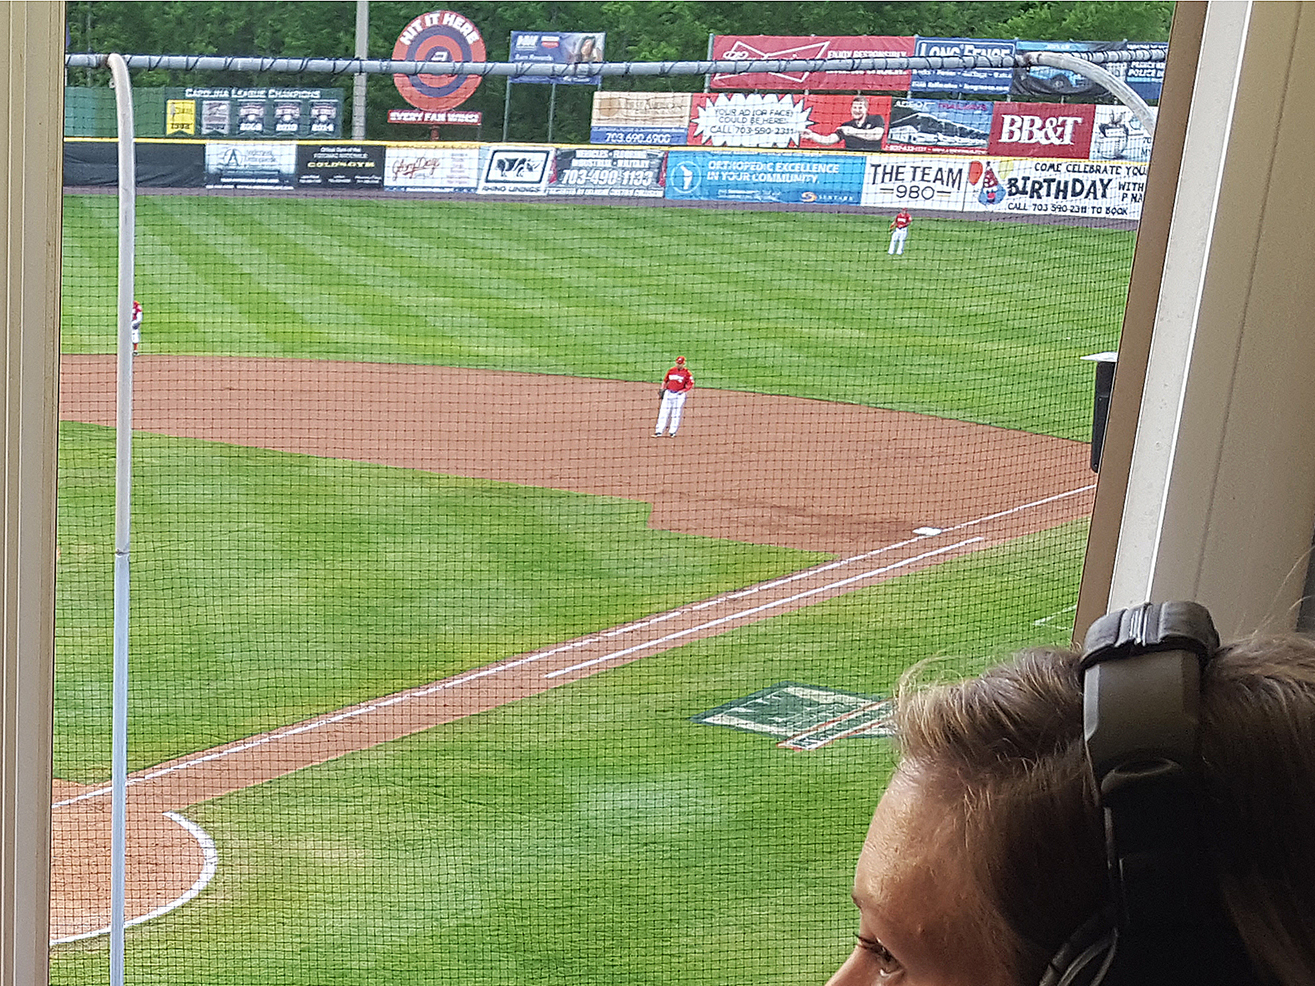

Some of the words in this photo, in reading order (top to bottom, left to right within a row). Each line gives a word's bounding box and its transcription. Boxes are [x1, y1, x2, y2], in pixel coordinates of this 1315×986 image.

[399, 19, 424, 46] HIT
[424, 13, 442, 27] IT
[443, 13, 481, 46] HERE
[185, 88, 229, 98] CAROLINA
[231, 88, 266, 98] LEAGUE
[268, 88, 321, 99] CHAMPIONS
[389, 111, 423, 122] EVERY
[423, 112, 447, 123] FAN
[714, 109, 737, 117] YOUR
[738, 109, 751, 117] AD
[769, 108, 794, 118] FACE)
[719, 116, 747, 125] COULD
[749, 117, 761, 125] BE
[710, 125, 733, 135] CALL
[999, 114, 1082, 146] BB&T
[708, 161, 774, 172] ORTHOPEDIC
[775, 162, 839, 173] EXCELLENCE
[1034, 162, 1062, 172] COME
[1065, 163, 1121, 175] CELEBRATE
[561, 169, 654, 187] 703-490-1133
[707, 172, 717, 181] IN
[718, 173, 751, 182] YOUR
[870, 162, 908, 186] THE
[909, 165, 963, 190] TEAM
[896, 184, 936, 201] 980
[1008, 177, 1114, 200] BIRTHDAY
[1118, 181, 1145, 192] WITH
[1008, 202, 1029, 211] CALL
[1032, 203, 1049, 212] 703
[1091, 206, 1103, 214] TO
[1105, 206, 1129, 215] BOOK
